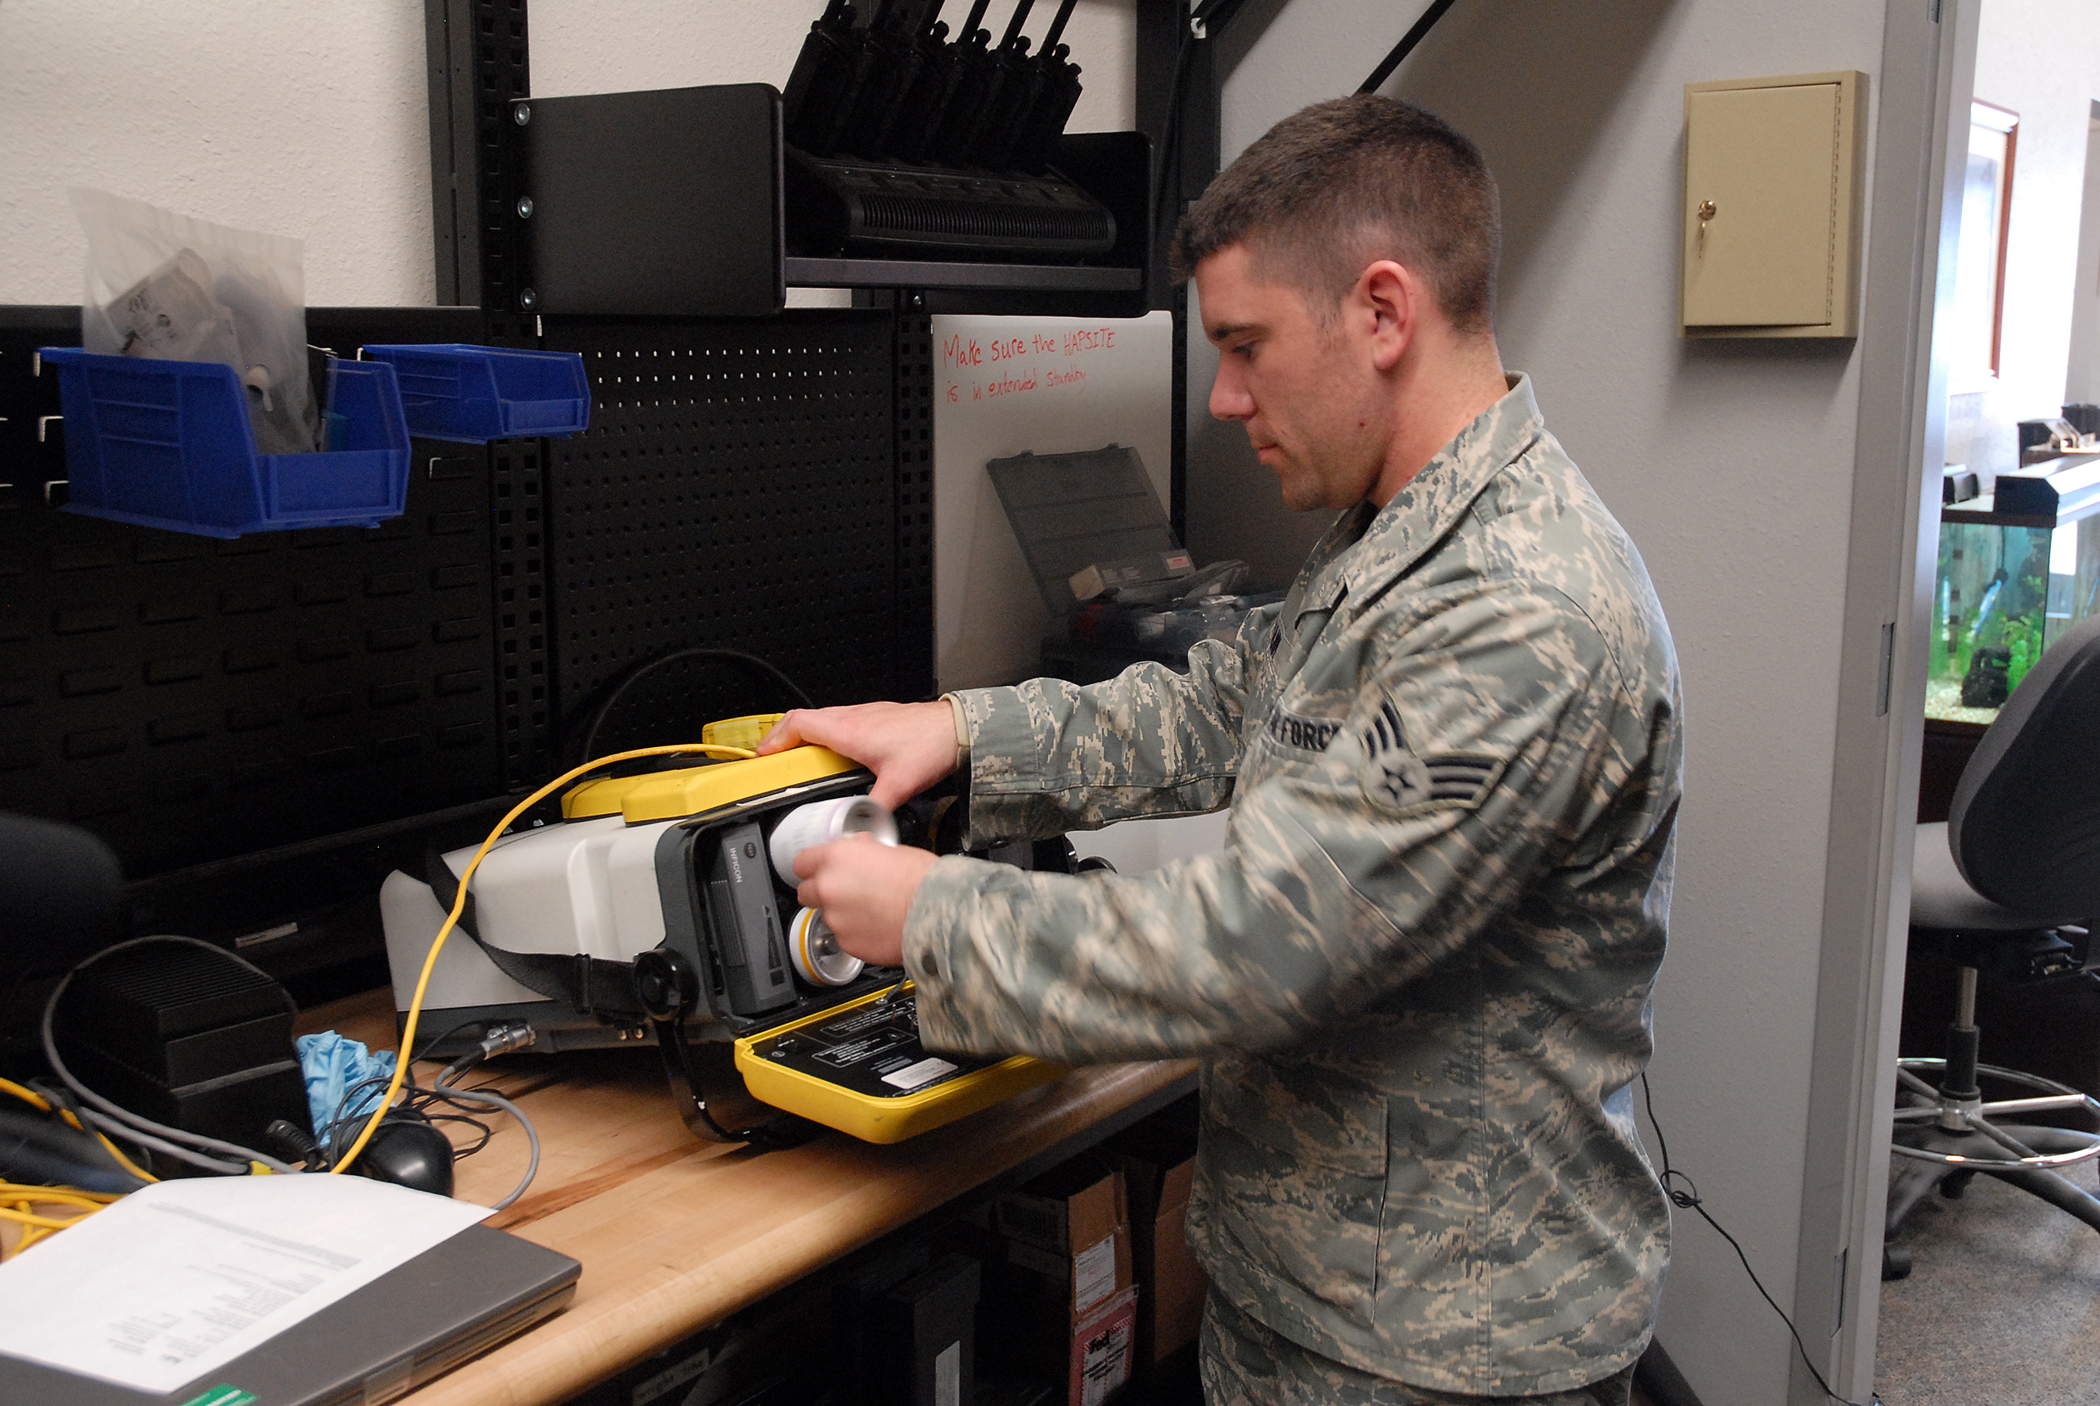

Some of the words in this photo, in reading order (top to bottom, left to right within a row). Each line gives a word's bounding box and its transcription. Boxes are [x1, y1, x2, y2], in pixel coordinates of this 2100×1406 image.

[944, 334, 982, 369] Make
[1032, 333, 1056, 353] the
[1064, 328, 1115, 356] HAPSITE
[947, 381, 958, 402] is
[973, 381, 981, 400] in
[989, 367, 1037, 397] extended
[730, 847, 742, 883] INFICON
